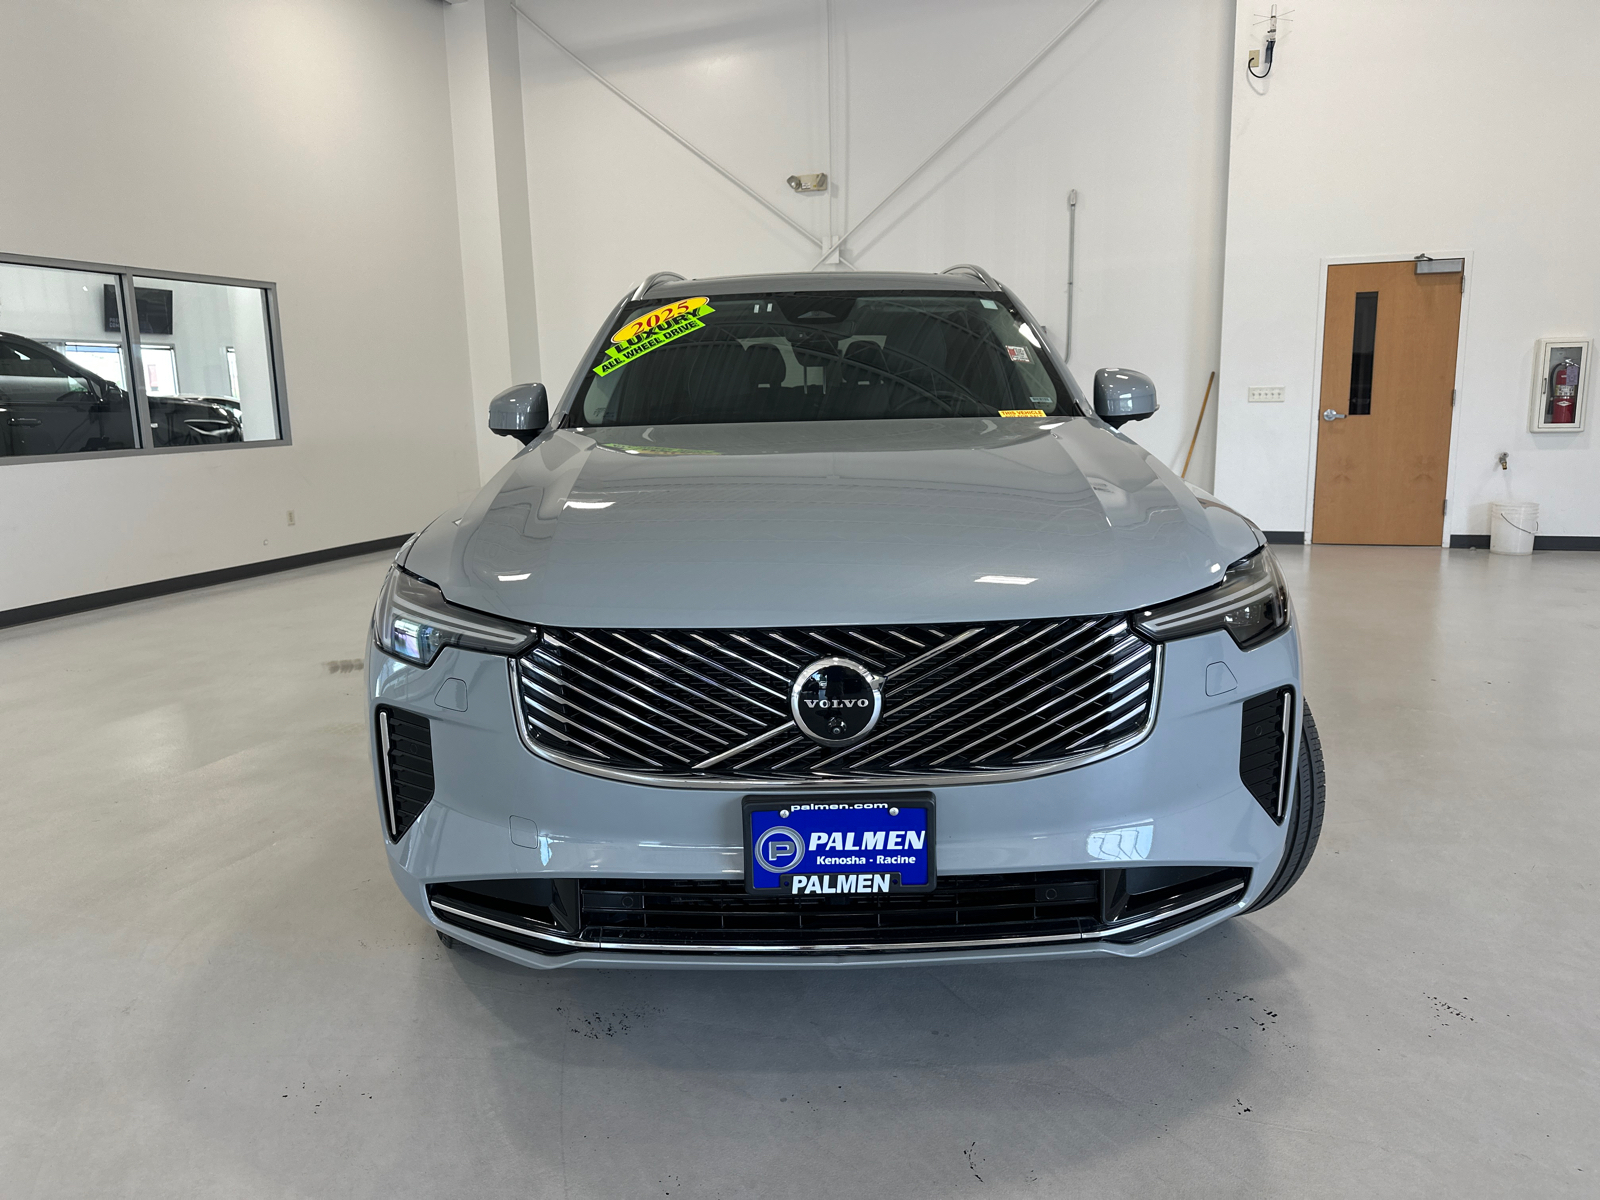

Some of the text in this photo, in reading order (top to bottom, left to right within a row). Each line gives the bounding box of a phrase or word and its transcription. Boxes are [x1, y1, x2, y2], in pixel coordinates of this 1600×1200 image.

[631, 301, 689, 336] 2025
[614, 307, 700, 353] LUXURY
[601, 320, 699, 373] ALL WHEEL DRIVE
[804, 698, 869, 708] VOLVO
[791, 803, 888, 812] palmen.com
[808, 831, 926, 851] PALMEN
[816, 855, 866, 865] Kenosha
[876, 855, 916, 864] Racine
[792, 874, 891, 894] PALMEN
